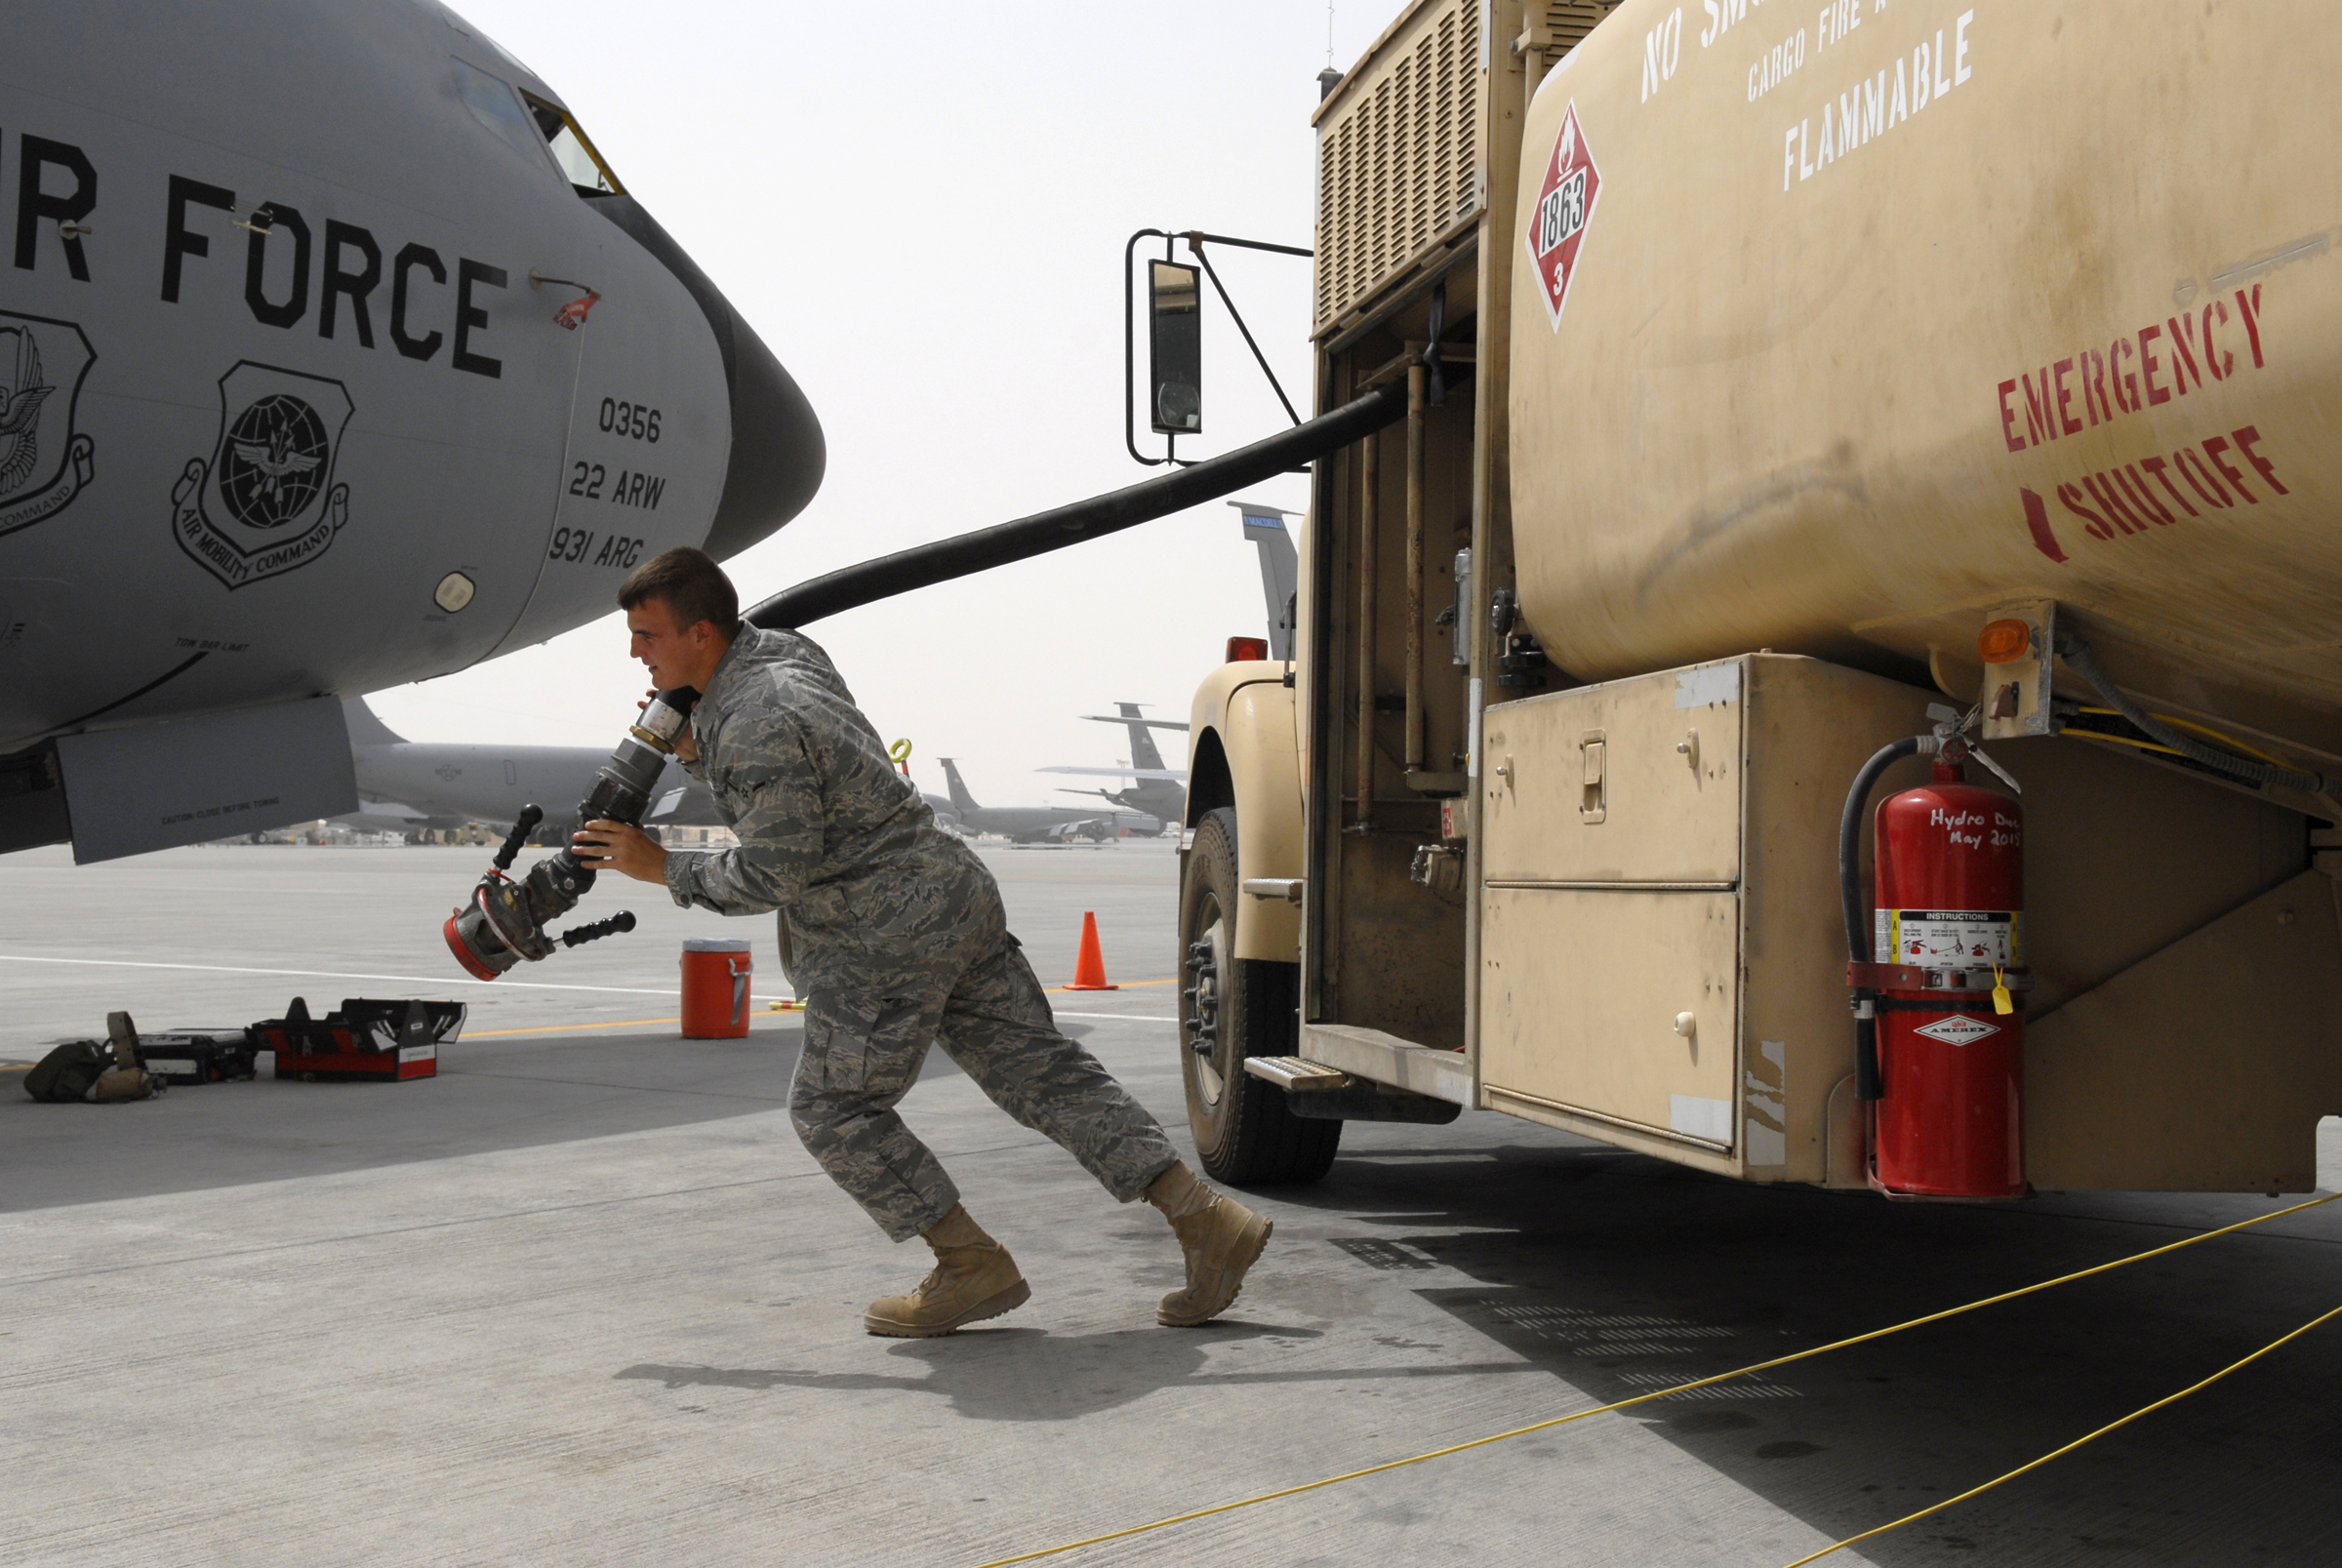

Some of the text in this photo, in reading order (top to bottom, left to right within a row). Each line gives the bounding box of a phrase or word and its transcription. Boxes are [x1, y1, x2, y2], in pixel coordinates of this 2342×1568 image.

[1640, 6, 1682, 104] NO
[1748, 0, 1861, 102] CARGO FIRE
[1784, 8, 1974, 191] FLAMMABLE
[1542, 172, 1585, 254] 1863
[161, 173, 508, 380] FORCE
[1553, 261, 1564, 297] 3
[1998, 283, 2265, 453] EMERGENCY
[599, 396, 662, 444] 0356
[569, 461, 666, 510] 22 ARW
[2056, 424, 2290, 541] SHUTOFF
[182, 508, 330, 580] AIR MOBILITY COMMAND
[549, 527, 644, 569] 931 ARG
[174, 637, 251, 652] TOW BAR LIMIT
[1930, 808, 1985, 830] Hydro
[1950, 830, 1982, 850] May
[1926, 912, 1989, 921] INSTRUCTIONS
